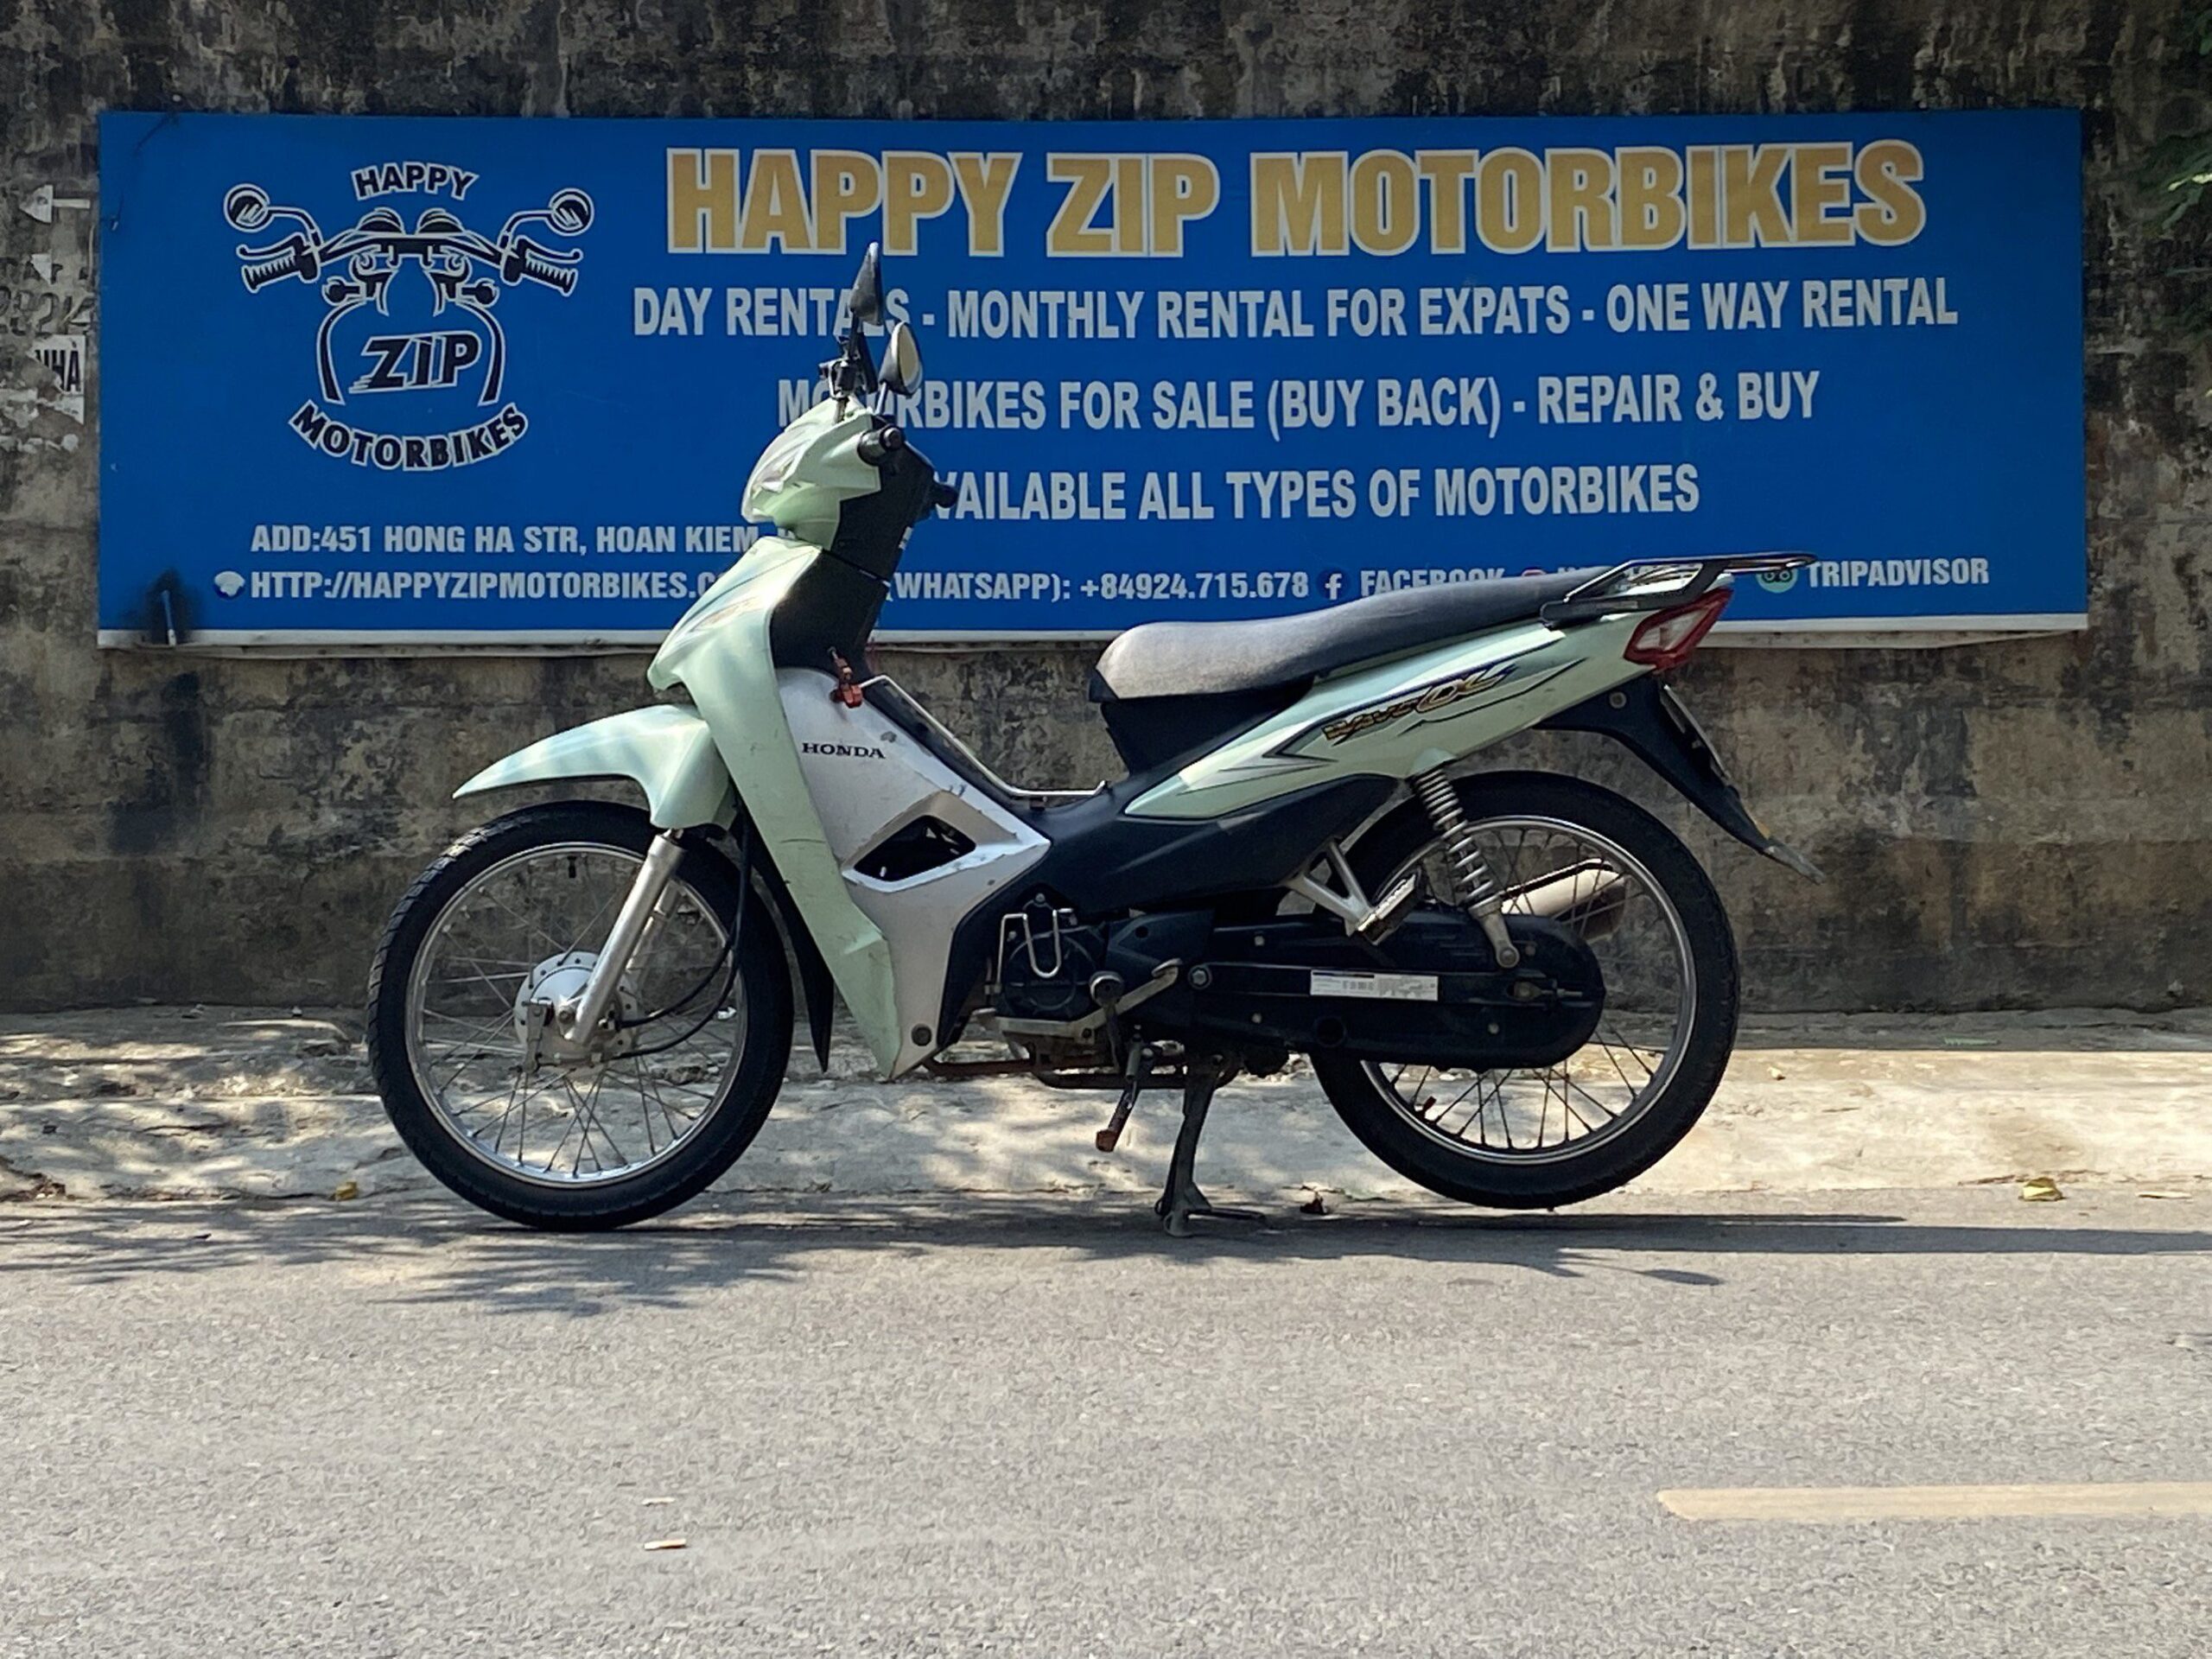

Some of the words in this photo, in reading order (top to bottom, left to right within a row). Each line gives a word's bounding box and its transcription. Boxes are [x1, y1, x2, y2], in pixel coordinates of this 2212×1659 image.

[351, 162, 480, 200] HAPPY
[665, 147, 1023, 258] HAPPY
[1046, 152, 1220, 258] ZIP
[1249, 139, 1927, 257] MOTORBIKES
[634, 287, 713, 335] DAY
[948, 289, 1145, 338] MONTHLY
[1158, 289, 1314, 338] RENTAL
[1327, 289, 1407, 337] FOR
[1420, 285, 1571, 335] EXPATS
[1606, 283, 1690, 333] ONE
[1701, 281, 1789, 330] WAY
[1802, 277, 1958, 327] RENTAL
[348, 330, 480, 395] ZIP
[288, 398, 529, 472] MOTORBIKES
[1060, 381, 1141, 429] FOR
[1153, 380, 1255, 429] SALE
[1268, 379, 1364, 442] (BUY
[1377, 377, 1501, 438] BACK)
[1538, 374, 1681, 423] REPAIR
[1695, 372, 1725, 422] &
[1738, 371, 1820, 420] BUY
[1138, 471, 1214, 520] ALL
[1225, 468, 1357, 518] TYPES
[1369, 468, 1421, 518] OF
[1434, 462, 1700, 516] MOTORBIKES
[251, 524, 371, 553] ADD:451
[385, 525, 465, 553] HONG
[474, 525, 515, 553] HA
[524, 525, 588, 556] STR,
[596, 525, 676, 553] HOAN
[685, 525, 759, 553] KIEM
[1080, 571, 1309, 600] +84924.715.678
[1806, 557, 1990, 588] TRIPADVISOR
[801, 742, 886, 760] HONDA
